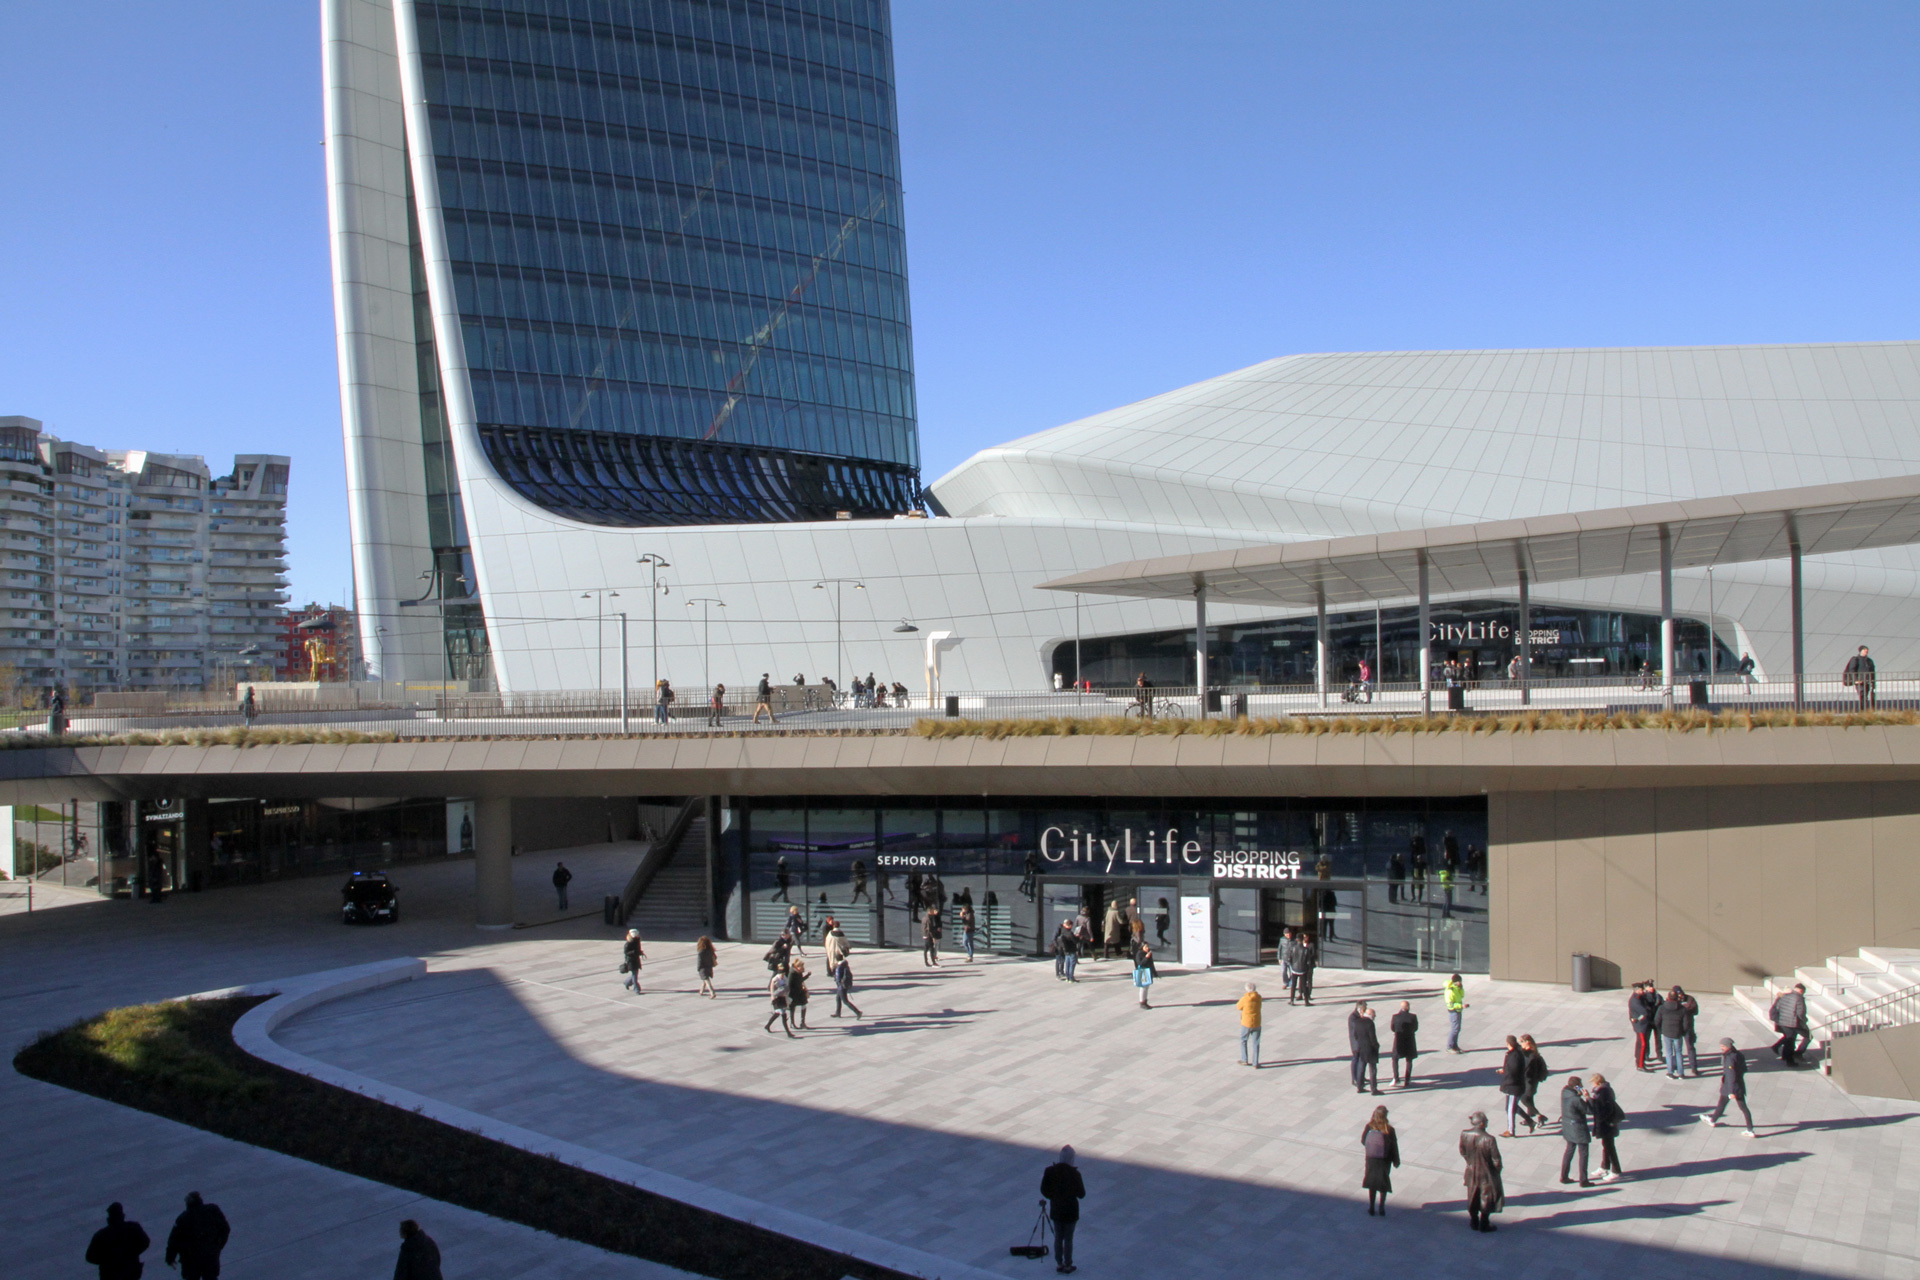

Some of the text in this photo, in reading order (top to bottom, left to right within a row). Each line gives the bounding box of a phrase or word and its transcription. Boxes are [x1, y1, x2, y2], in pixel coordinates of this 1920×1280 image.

[1040, 826, 1201, 873] CityLife
[877, 855, 936, 866] SEPHORA
[1213, 850, 1300, 864] SHOPPING
[1213, 864, 1301, 879] DISTRICT
